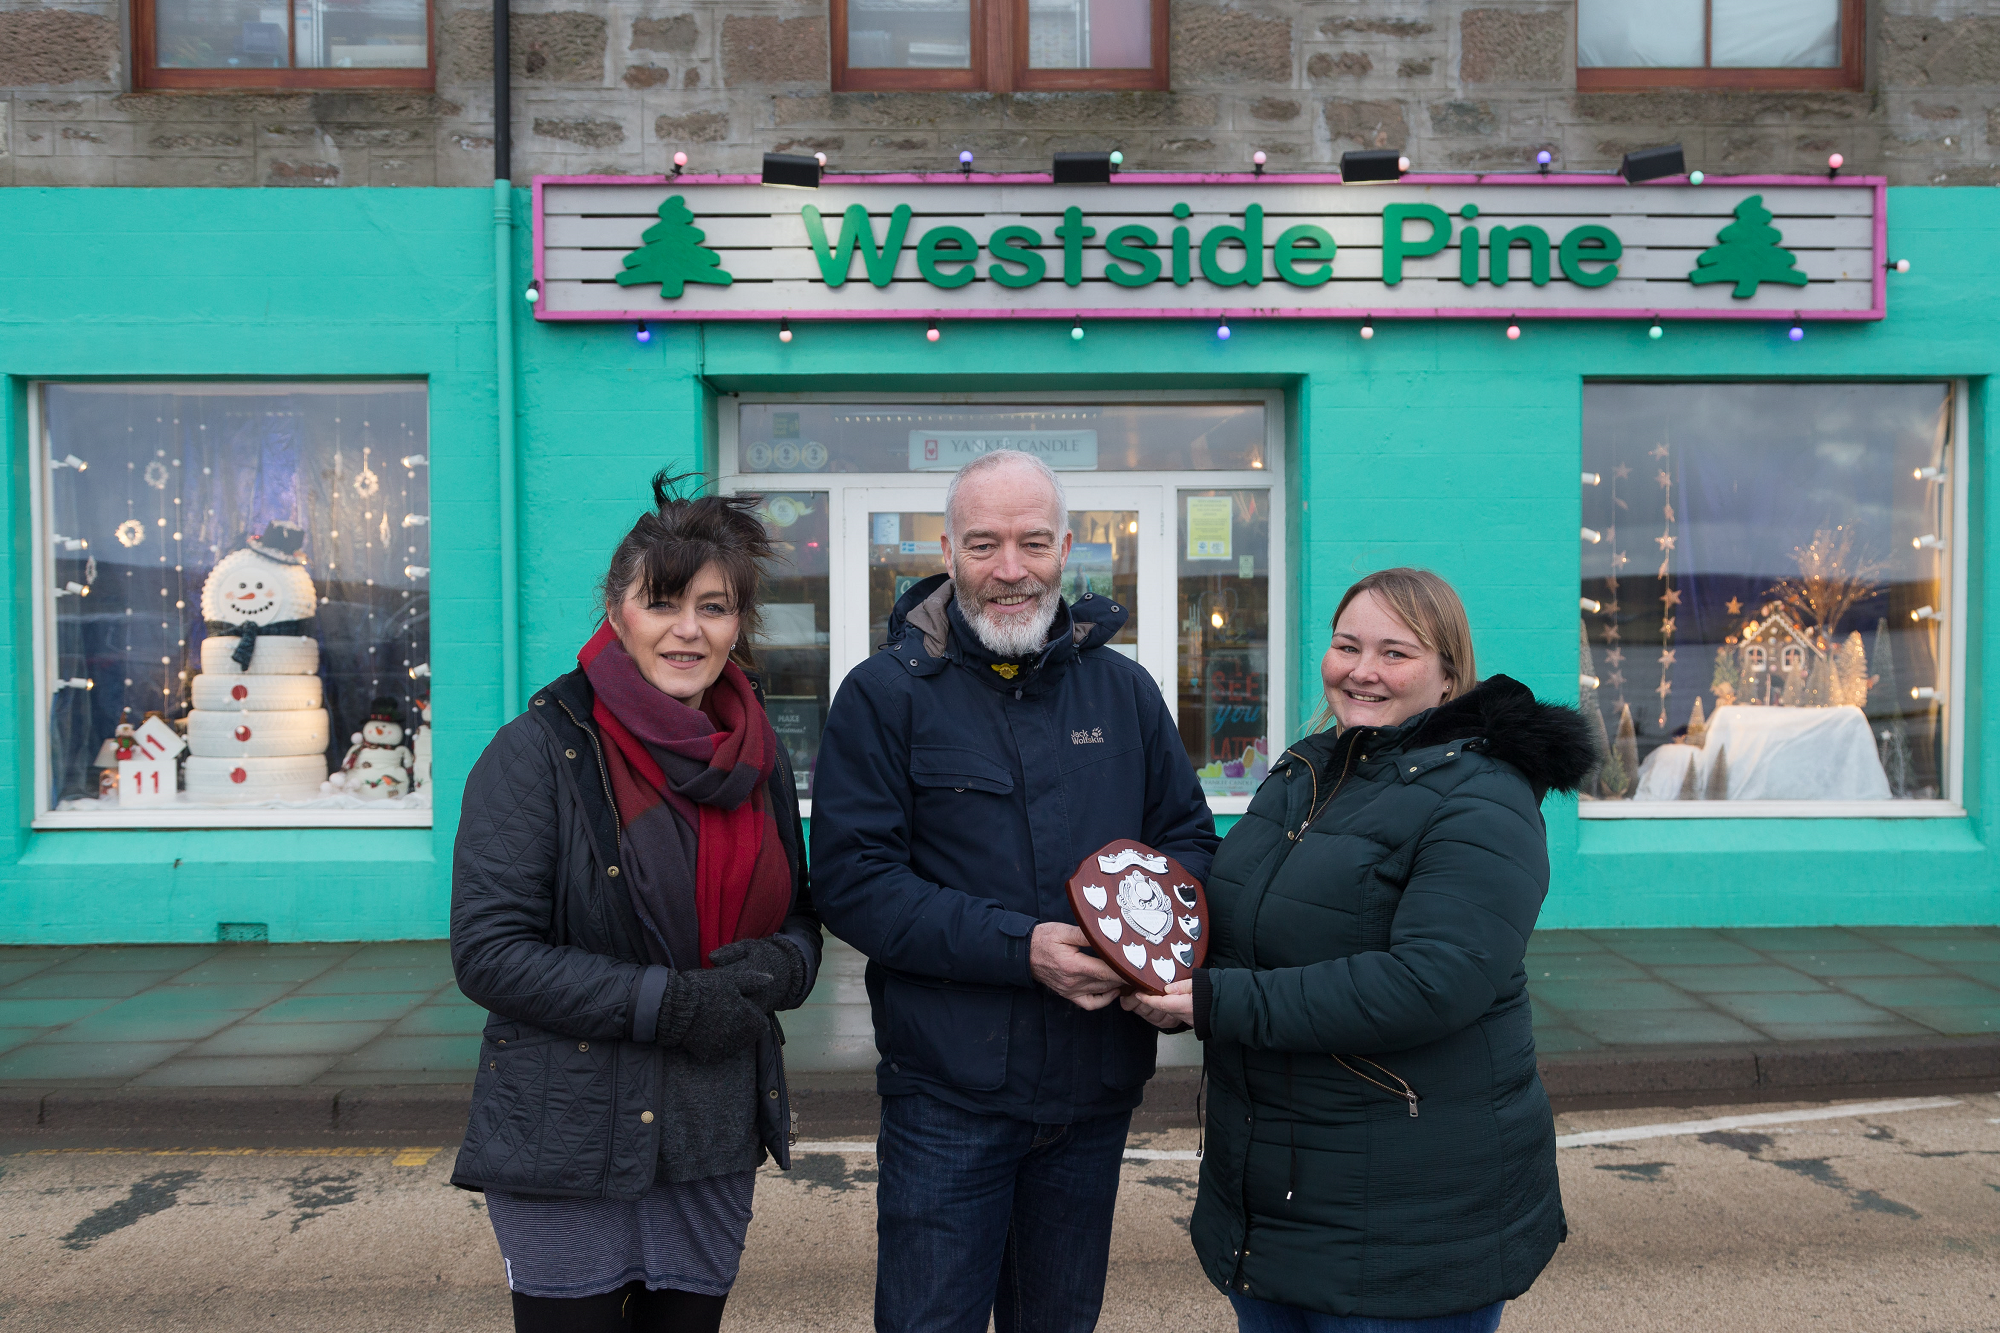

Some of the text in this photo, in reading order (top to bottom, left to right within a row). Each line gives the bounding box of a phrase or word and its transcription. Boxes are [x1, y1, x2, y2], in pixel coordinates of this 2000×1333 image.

[802, 203, 1623, 289] Westside Pine
[951, 438, 1079, 452] YANKEE CANDLE
[1211, 671, 1260, 702] SEE
[1210, 704, 1261, 734] you
[1070, 729, 1089, 738] Jack
[1071, 736, 1104, 745] Wolfskin
[133, 771, 159, 794] 11
